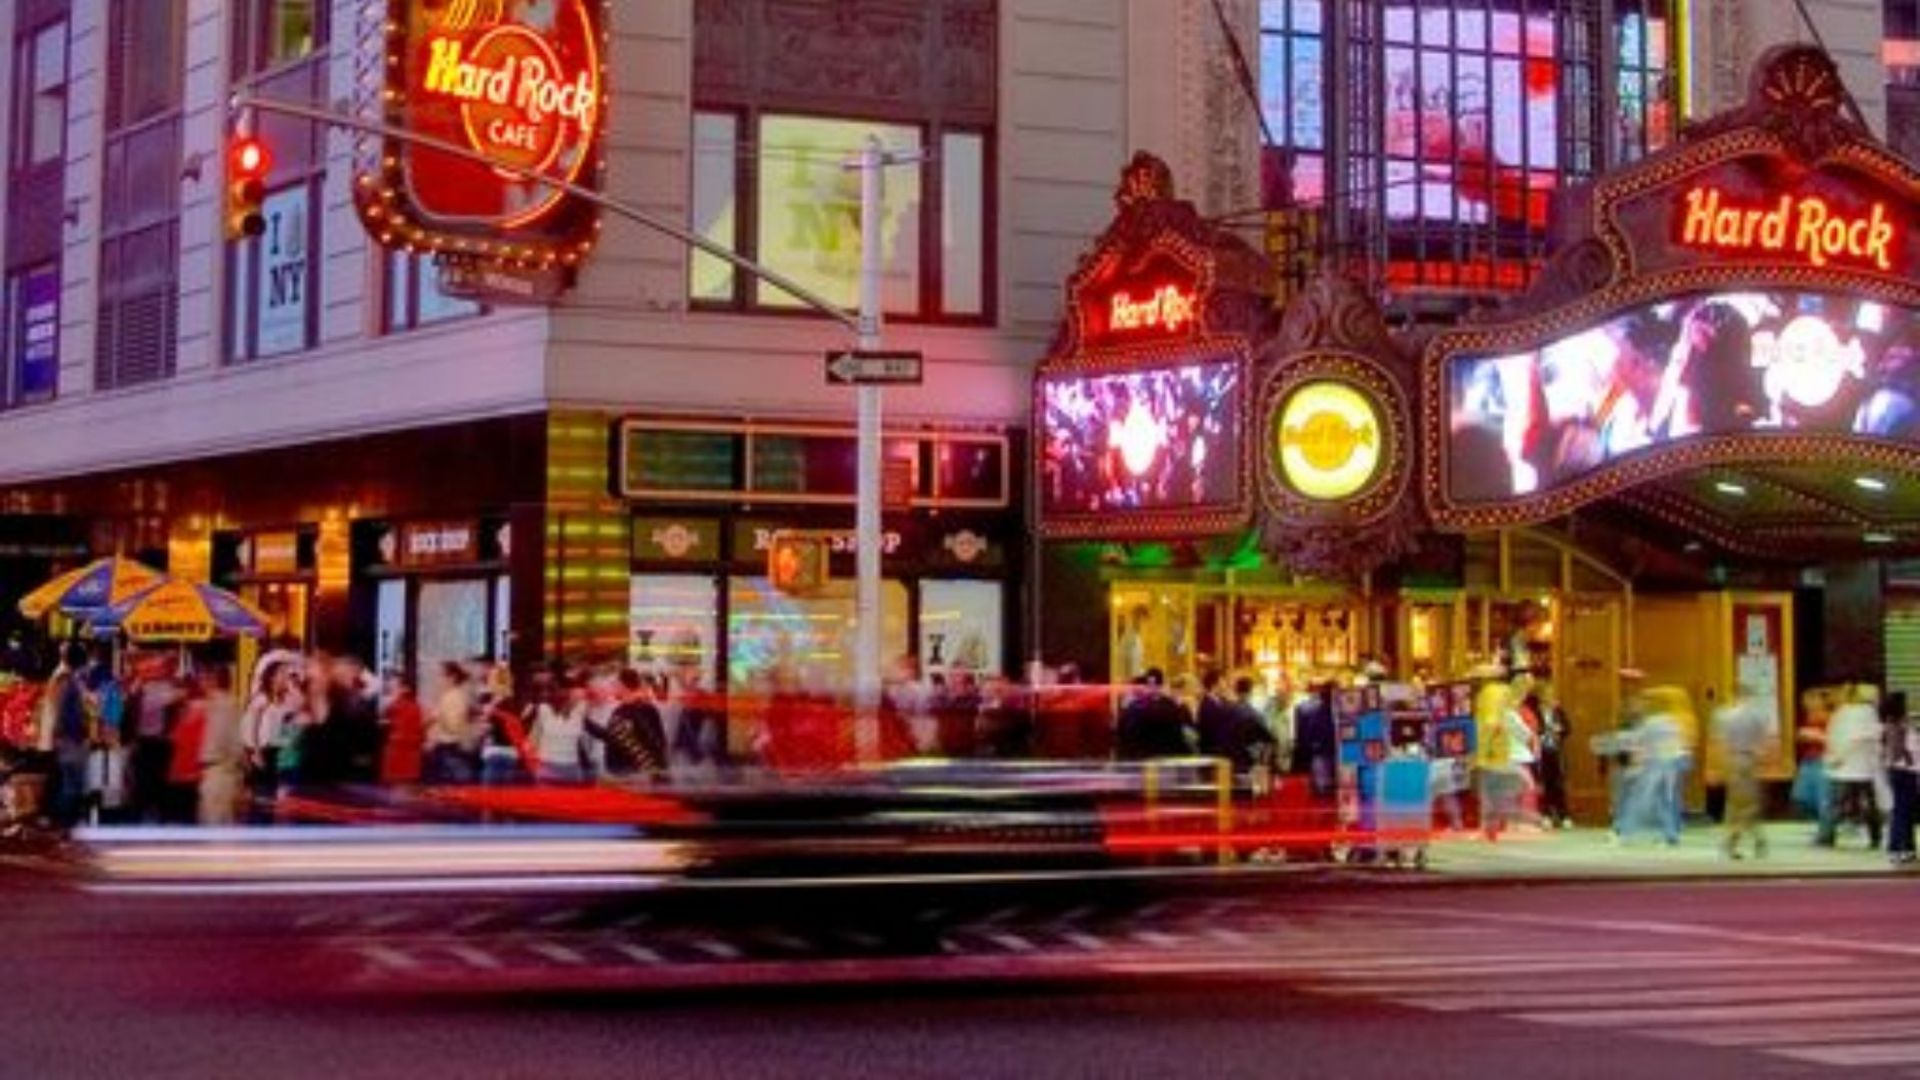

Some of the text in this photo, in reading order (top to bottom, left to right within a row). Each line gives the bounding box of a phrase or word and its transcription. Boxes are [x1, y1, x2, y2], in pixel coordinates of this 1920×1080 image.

[424, 37, 597, 132] Hard Rock
[1684, 187, 1893, 270] Hard Rock
